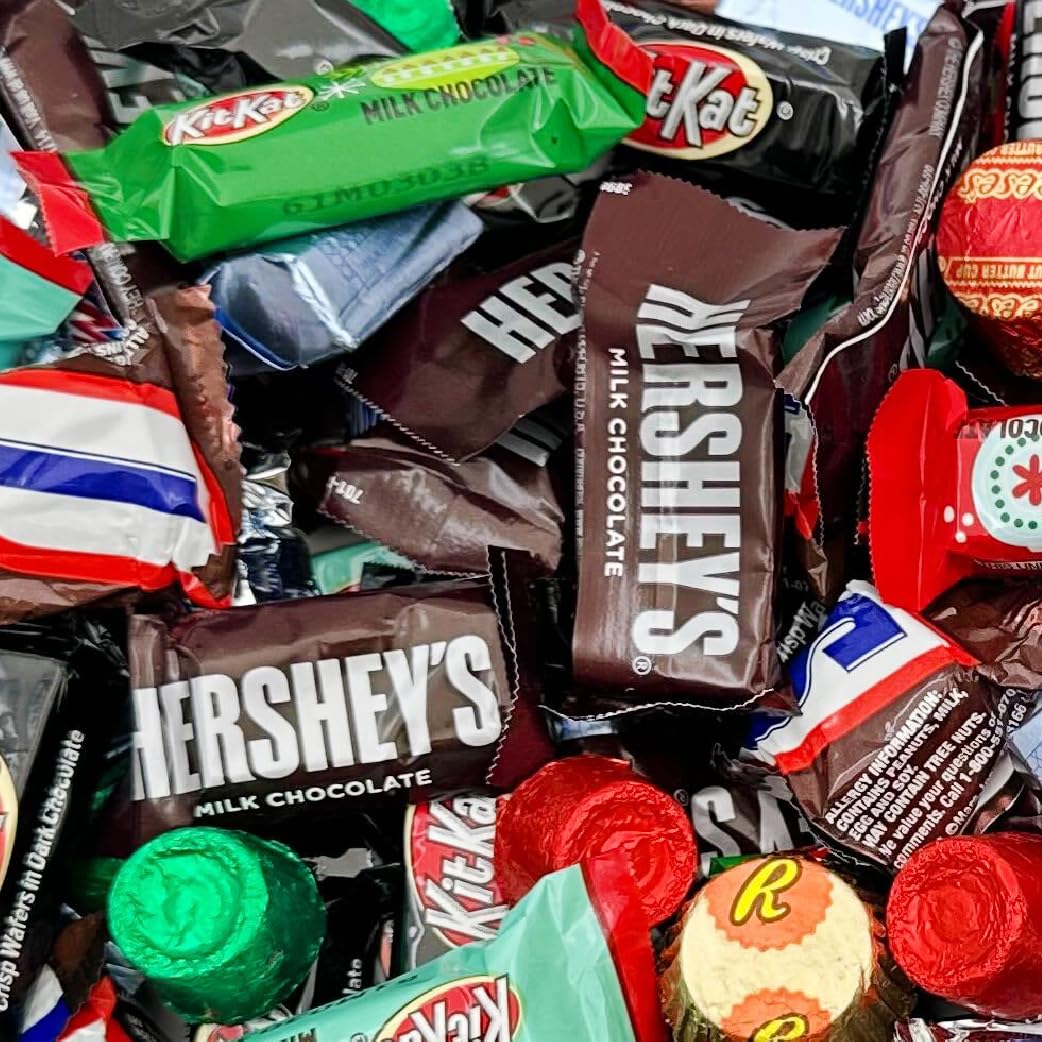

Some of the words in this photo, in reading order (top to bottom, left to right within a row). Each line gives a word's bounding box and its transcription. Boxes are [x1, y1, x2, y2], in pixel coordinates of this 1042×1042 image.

[166, 79, 312, 145] KitKat
[360, 89, 424, 125] MILK
[423, 61, 557, 112] CHOCOLATE
[644, 60, 760, 148] tKat
[608, 347, 629, 409] MILK
[603, 418, 628, 578] CHOCOLATE
[632, 283, 751, 656] HERSHEY'S
[133, 636, 500, 801] HERSHEY'S
[823, 769, 874, 828] ALLERGY
[866, 686, 944, 778] INFORMATION:
[834, 771, 890, 835] CONTAINS
[884, 717, 939, 781] PEANUTS,
[932, 684, 969, 725] MILK,
[41, 729, 85, 826] Chocolate
[194, 795, 257, 819] MILK
[267, 768, 433, 808] CHOCOLATE
[847, 812, 874, 841] EGG
[869, 788, 896, 818] AND
[890, 760, 920, 793] SOY.
[862, 820, 889, 850] MAY
[882, 768, 930, 825] CONTAIN
[923, 738, 957, 775] TREE
[951, 705, 987, 746] NUTS.
[890, 804, 924, 842] value
[917, 778, 949, 812] your
[939, 723, 994, 785] questions
[32, 824, 57, 877] Dark
[425, 800, 510, 937] KitKa
[890, 804, 946, 870] comments.
[938, 780, 966, 810] Call
[5, 884, 38, 954] Wafers
[30, 871, 43, 893] in
[730, 858, 802, 926] R
